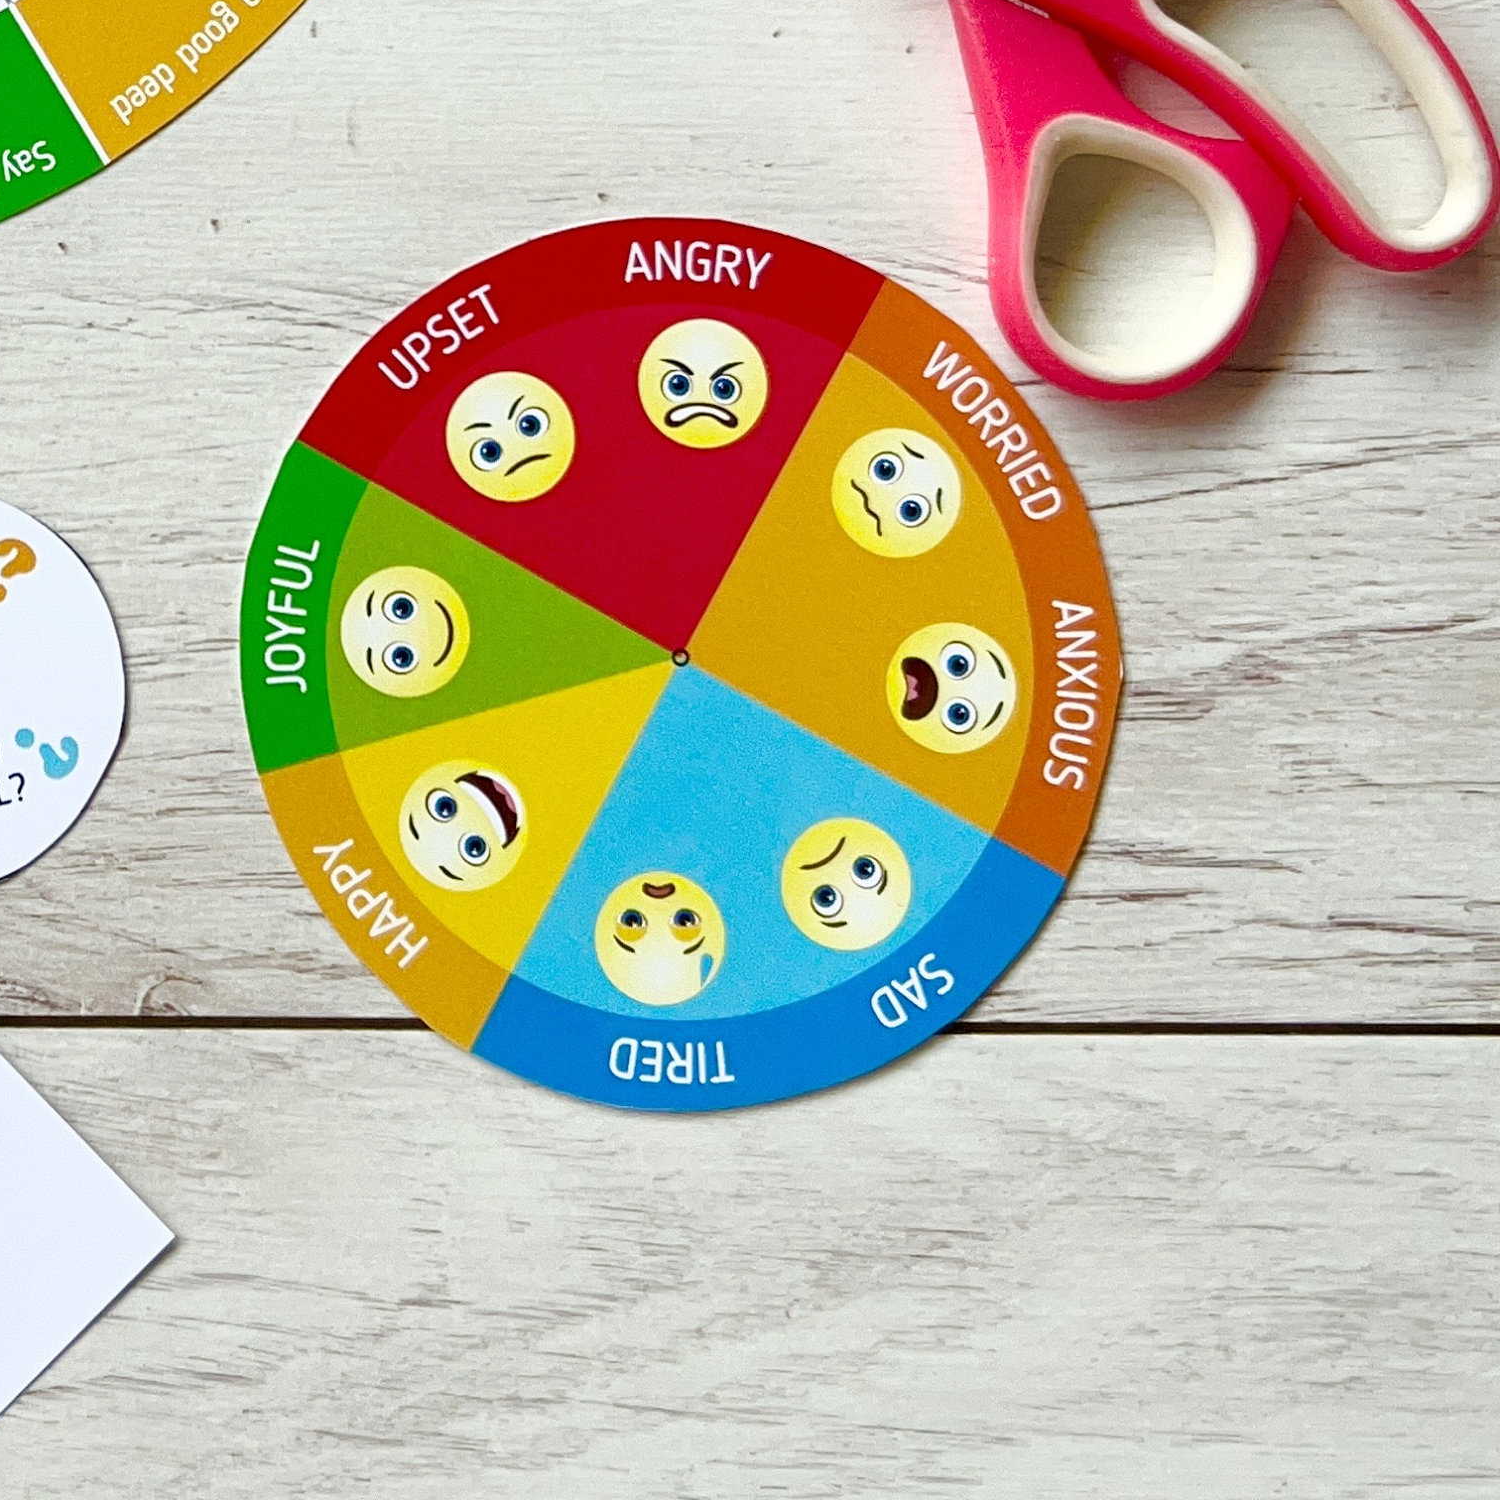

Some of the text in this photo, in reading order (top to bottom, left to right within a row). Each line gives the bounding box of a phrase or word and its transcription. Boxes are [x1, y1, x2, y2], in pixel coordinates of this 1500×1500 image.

[175, 0, 240, 73] good
[109, 63, 176, 126] deed
[2, 140, 56, 182] Say
[624, 240, 772, 290] ANGRY
[378, 284, 499, 390] UPSET
[923, 340, 1062, 520] WORRIED
[264, 539, 320, 693] JOYFUL
[1043, 600, 1097, 790] ANXIOUS
[312, 838, 429, 969] HAPPY
[871, 953, 954, 1028] SAD
[609, 1037, 735, 1085] TIRED
